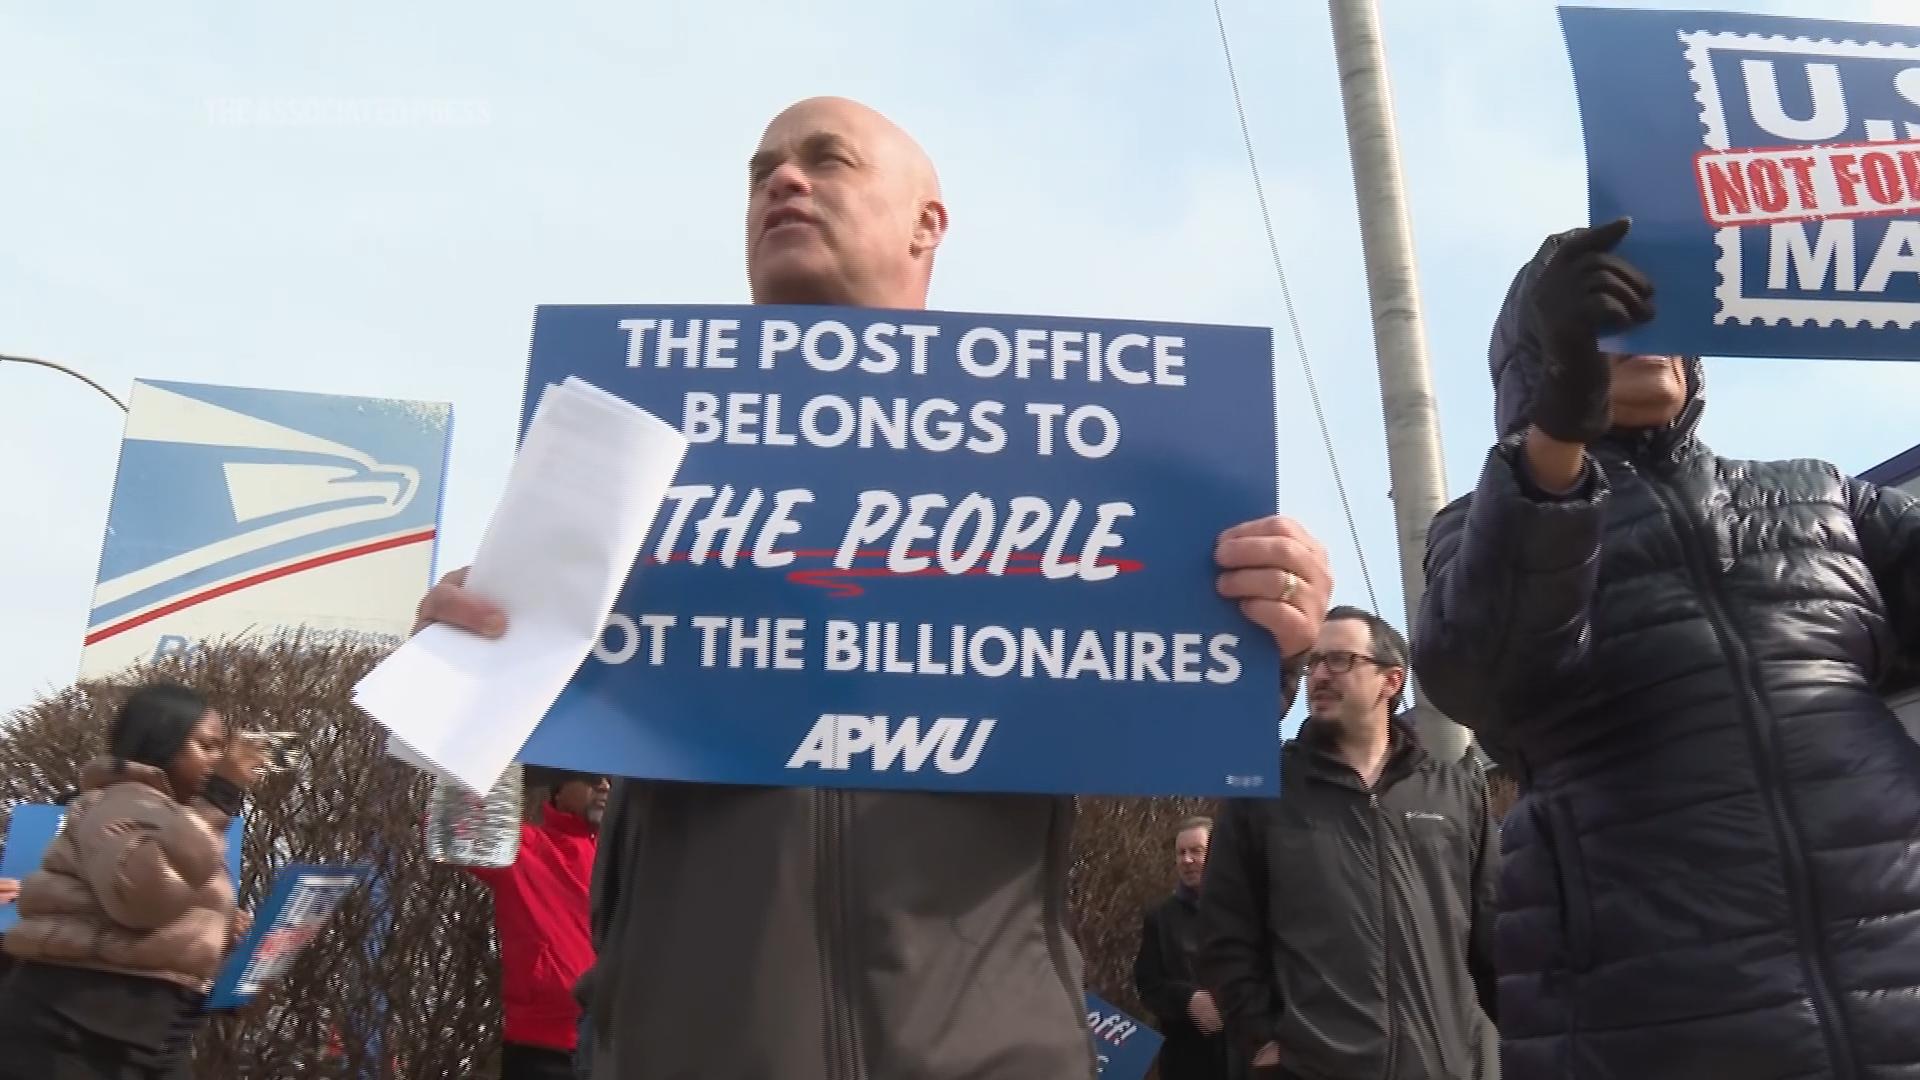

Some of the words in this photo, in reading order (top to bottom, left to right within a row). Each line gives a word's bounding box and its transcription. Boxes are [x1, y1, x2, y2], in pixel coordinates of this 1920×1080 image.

[1706, 157, 1818, 216] NOT
[617, 319, 741, 369] THE
[758, 319, 941, 376] POST
[956, 327, 1188, 387] OFFICE
[681, 391, 1008, 454] BELONGS
[1025, 402, 1121, 459] TO
[653, 484, 816, 569] THE
[833, 489, 1137, 582] PEOPLE
[593, 613, 678, 666] OT
[690, 615, 806, 669] THE
[824, 619, 1244, 684] BILLIONAIRES
[784, 713, 998, 775] APWU
